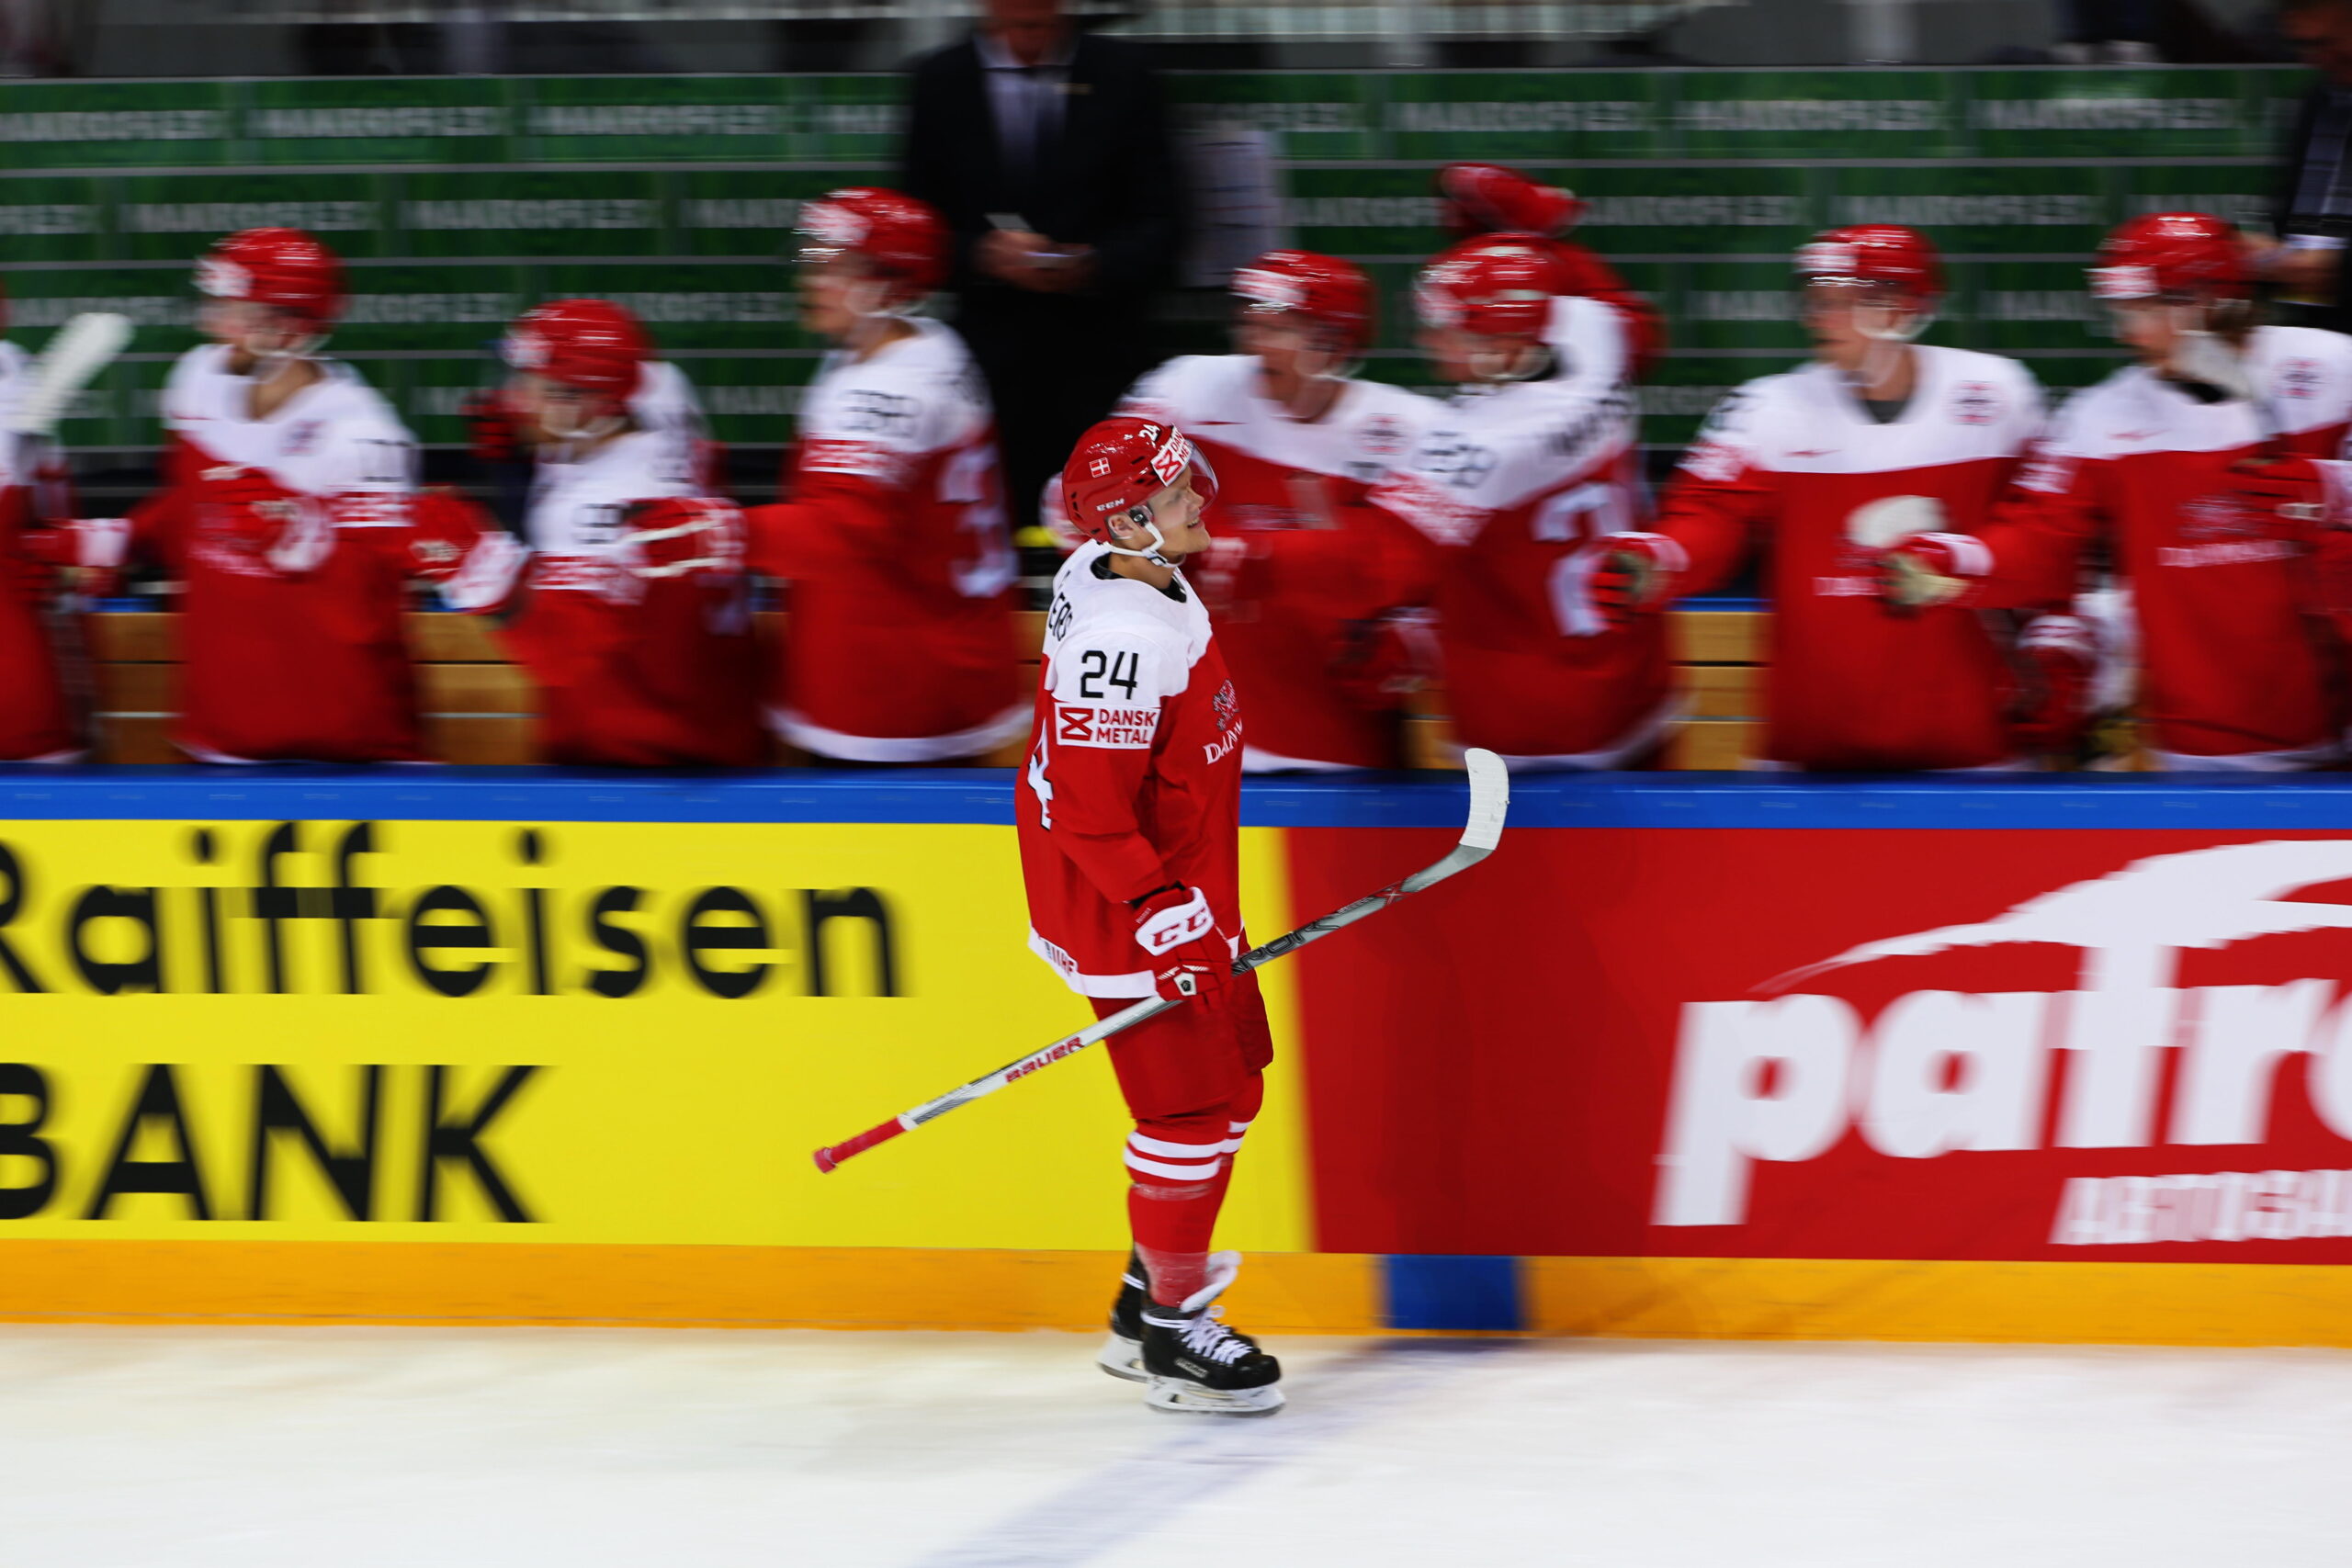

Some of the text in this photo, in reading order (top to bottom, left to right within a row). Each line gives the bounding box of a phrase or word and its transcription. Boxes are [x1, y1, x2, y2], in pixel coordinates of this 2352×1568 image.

[1137, 423, 1161, 442] 24
[1080, 649, 1139, 700] 24
[1098, 708, 1157, 727] DANSK
[1096, 727, 1150, 744] METAL
